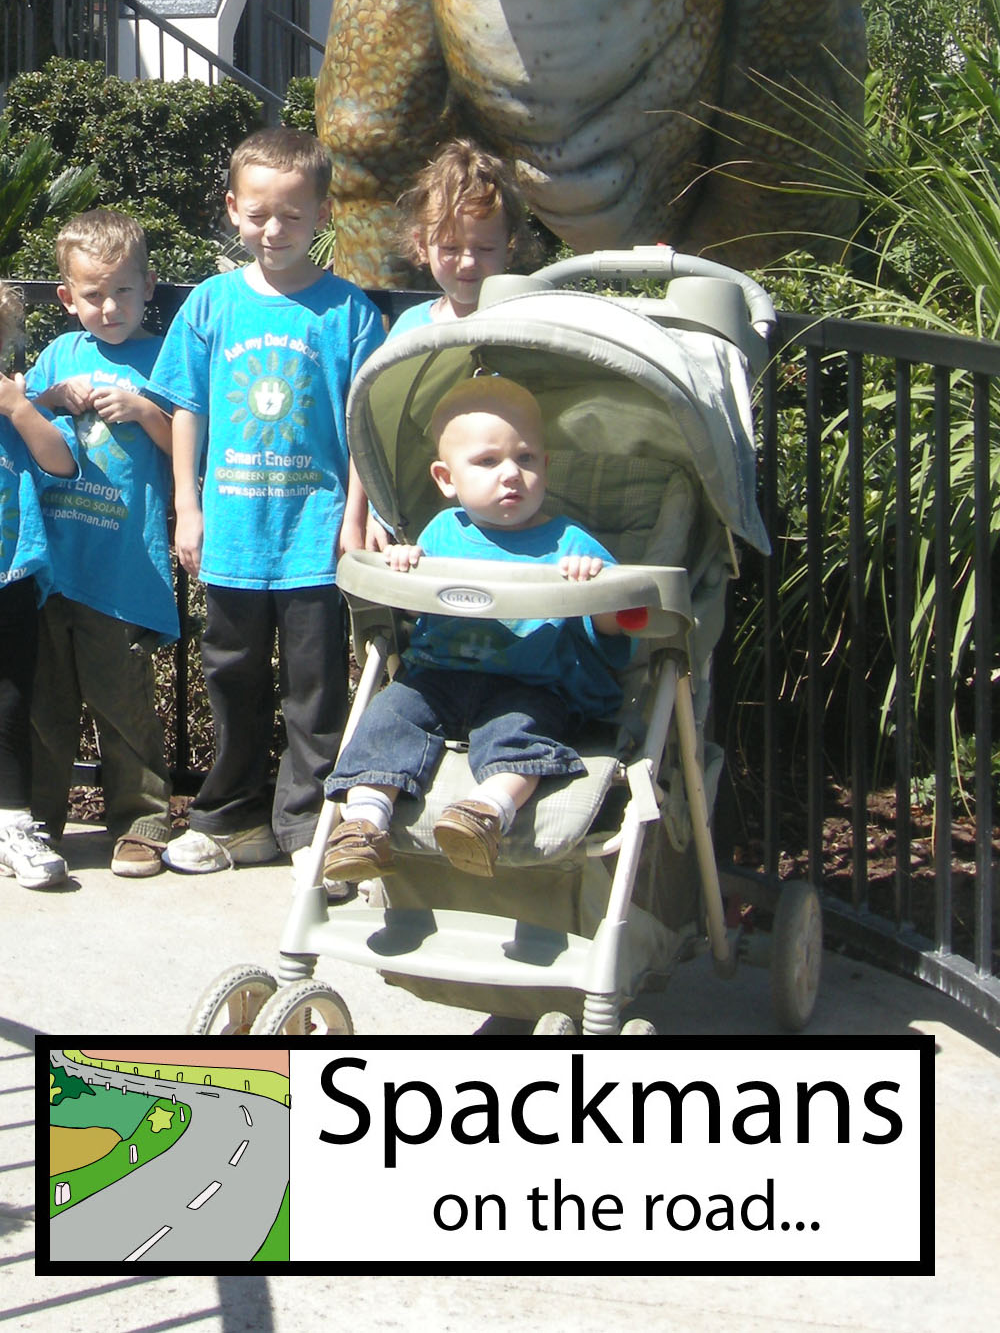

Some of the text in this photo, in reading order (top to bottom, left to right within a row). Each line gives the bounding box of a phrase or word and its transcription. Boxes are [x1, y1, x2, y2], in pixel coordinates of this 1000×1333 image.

[223, 342, 246, 362] Ask
[245, 337, 263, 350] my
[263, 333, 289, 347] Dad
[224, 447, 313, 468] Smart Energy
[217, 469, 234, 479] GO
[268, 471, 286, 482] GO
[287, 471, 319, 483] SOLAR!
[74, 477, 123, 502] Energy
[217, 484, 317, 498] www.spackman.info
[75, 497, 91, 508] GO
[446, 593, 487, 604] GRACO
